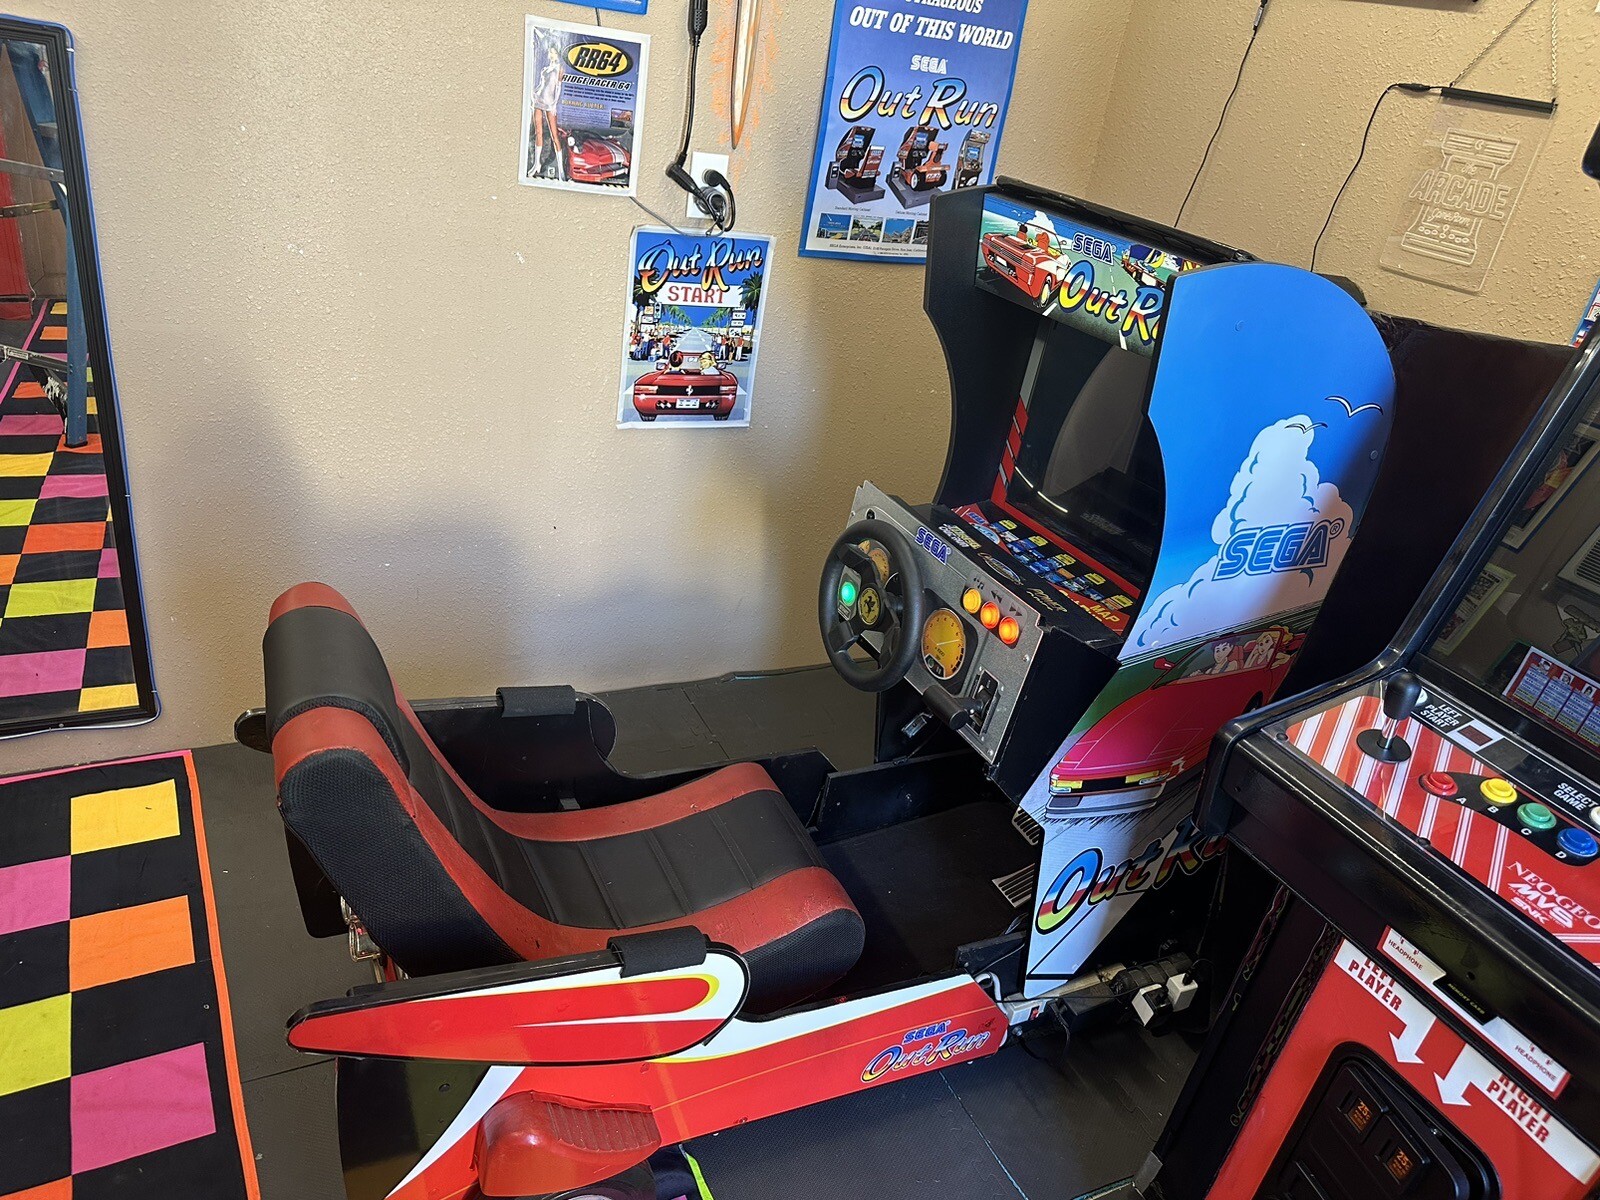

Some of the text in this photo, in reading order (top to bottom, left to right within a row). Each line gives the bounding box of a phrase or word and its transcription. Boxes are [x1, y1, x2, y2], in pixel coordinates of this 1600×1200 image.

[850, 6, 1013, 50] OUT OF THIS WORLD
[573, 47, 623, 72] RR64
[910, 55, 947, 74] SEGA
[562, 74, 631, 91] RIDGE RACER 64
[1409, 169, 1512, 219] ARCADE
[1072, 233, 1114, 265] SEGA
[668, 285, 725, 304] START
[915, 526, 948, 565] SEGA
[1090, 604, 1120, 622] MAP
[1420, 710, 1450, 728] START
[1425, 704, 1460, 727] PLAYER
[1438, 704, 1463, 718] LEFT
[1456, 797, 1467, 805] A
[1553, 789, 1587, 811] GAME
[1557, 782, 1599, 808] SELECT
[1487, 806, 1499, 814] B
[1520, 827, 1532, 836] C
[1554, 851, 1567, 859] D
[1507, 883, 1573, 928] MVS
[1511, 897, 1549, 924] SNK
[1388, 939, 1423, 971] HEADPHONE
[1348, 959, 1402, 1012] PLAYER
[1447, 983, 1485, 1015] MEMORY CARD
[1514, 1045, 1557, 1082] HEADPHONE
[1486, 1079, 1550, 1143] PLAYER
